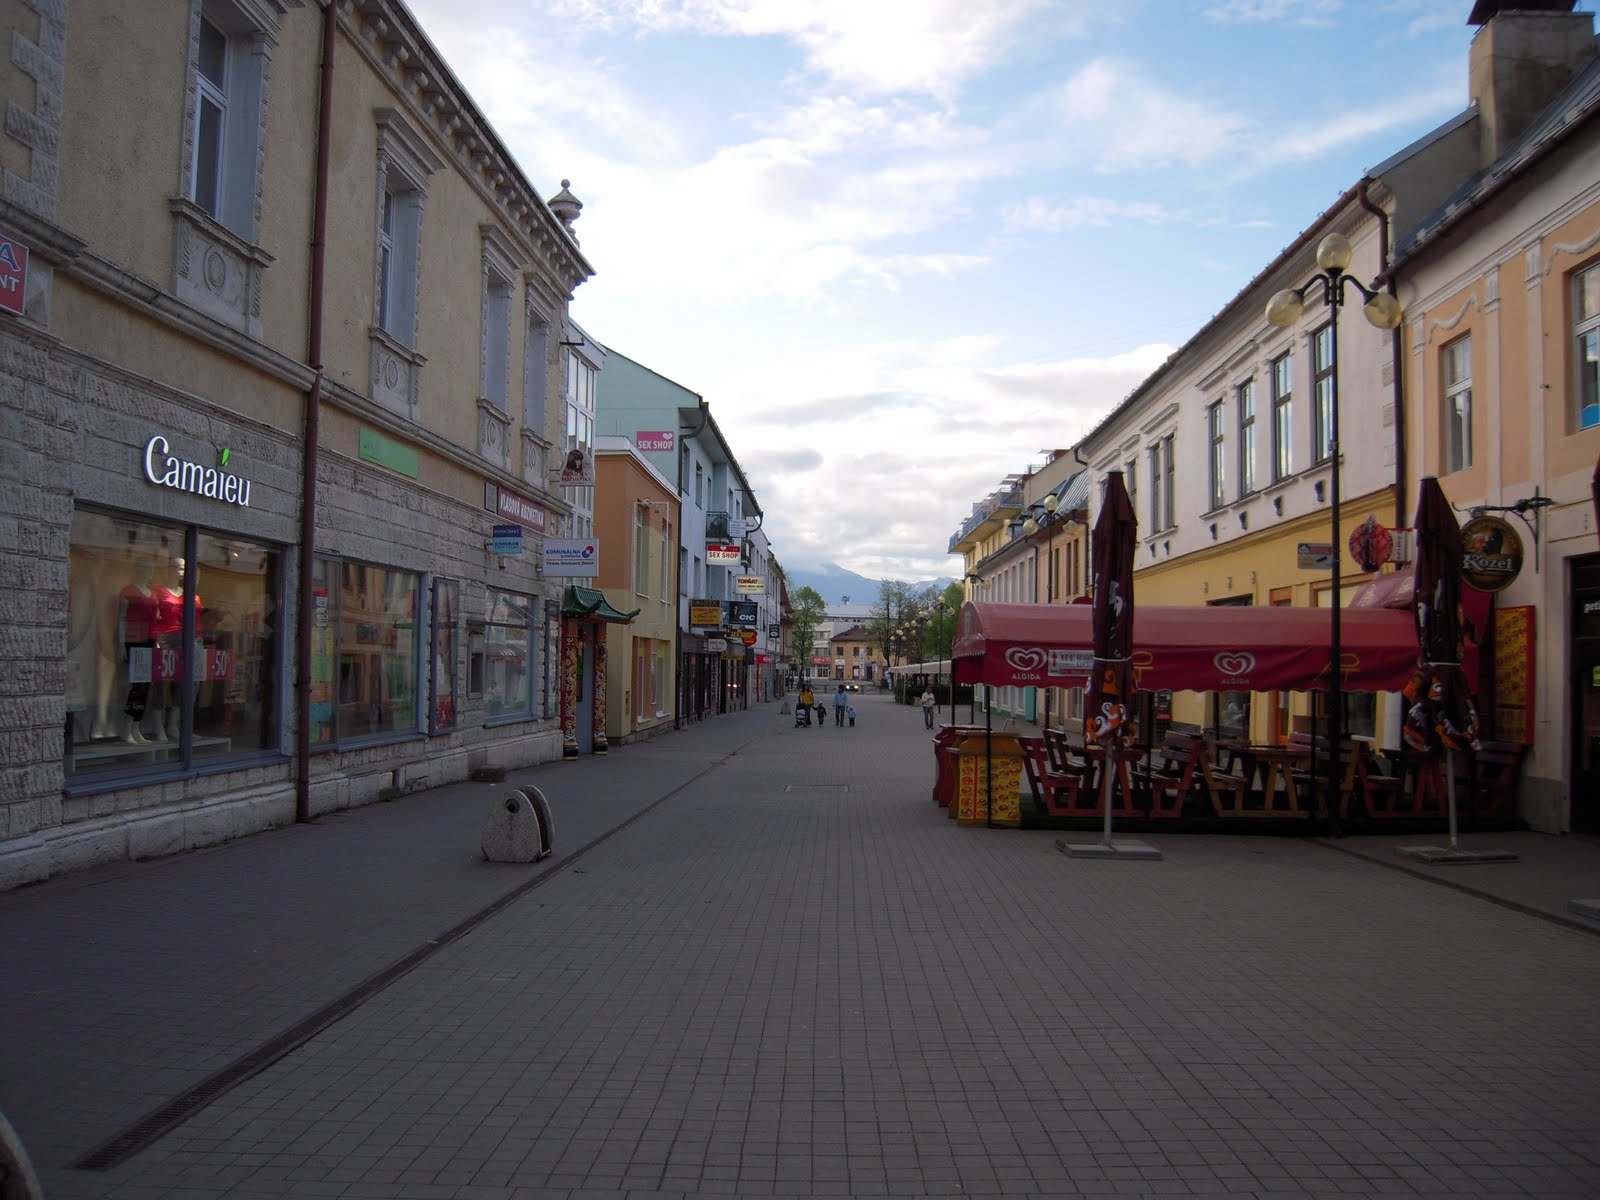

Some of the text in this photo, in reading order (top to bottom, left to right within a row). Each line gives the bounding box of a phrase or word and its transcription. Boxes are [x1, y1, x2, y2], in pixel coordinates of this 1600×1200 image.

[637, 440, 673, 450] SEX SHOP
[520, 504, 544, 527] KOZMETIKA
[1462, 554, 1514, 572] Kozel
